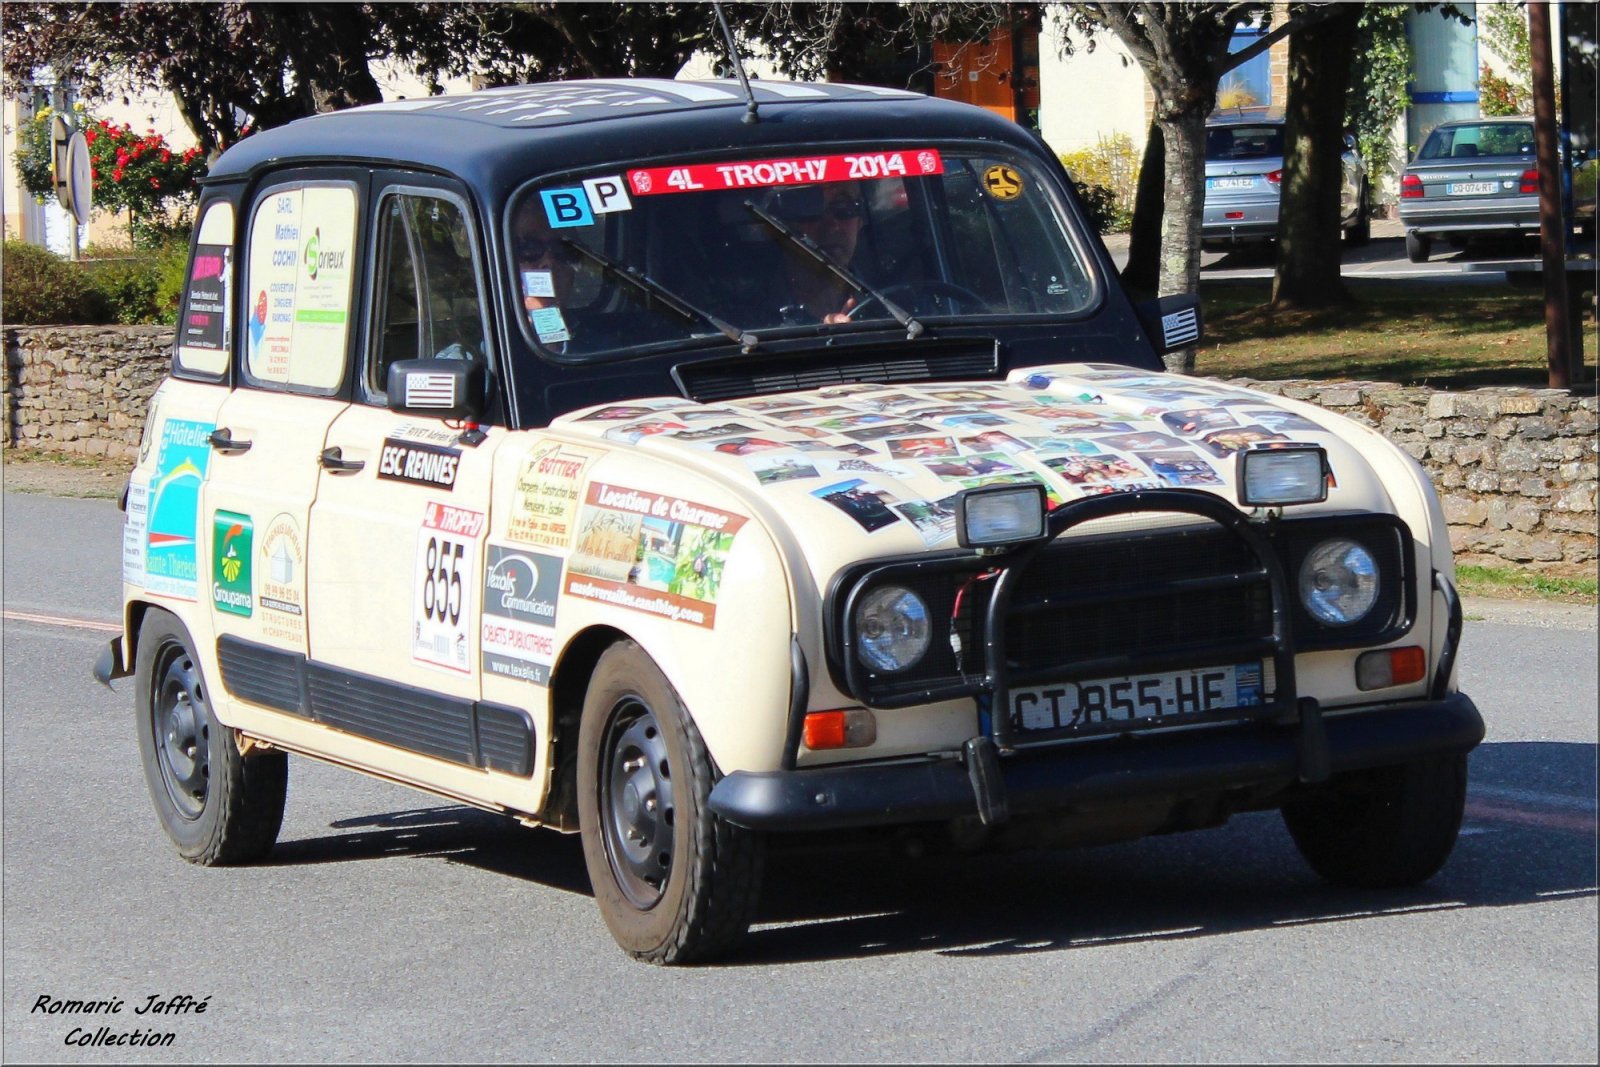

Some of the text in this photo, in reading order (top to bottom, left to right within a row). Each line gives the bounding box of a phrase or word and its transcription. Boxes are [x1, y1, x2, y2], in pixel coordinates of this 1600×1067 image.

[667, 153, 906, 190] 4L TROPHY 2014
[551, 193, 583, 222] B
[594, 182, 618, 208] P
[169, 422, 209, 448] Hôtelie
[380, 446, 458, 485] ESC RENNES
[439, 506, 484, 537] TROPHY
[598, 485, 729, 530] Location de Charme
[213, 581, 252, 609] Groupama
[424, 536, 464, 627] 855
[501, 591, 554, 617] Communication
